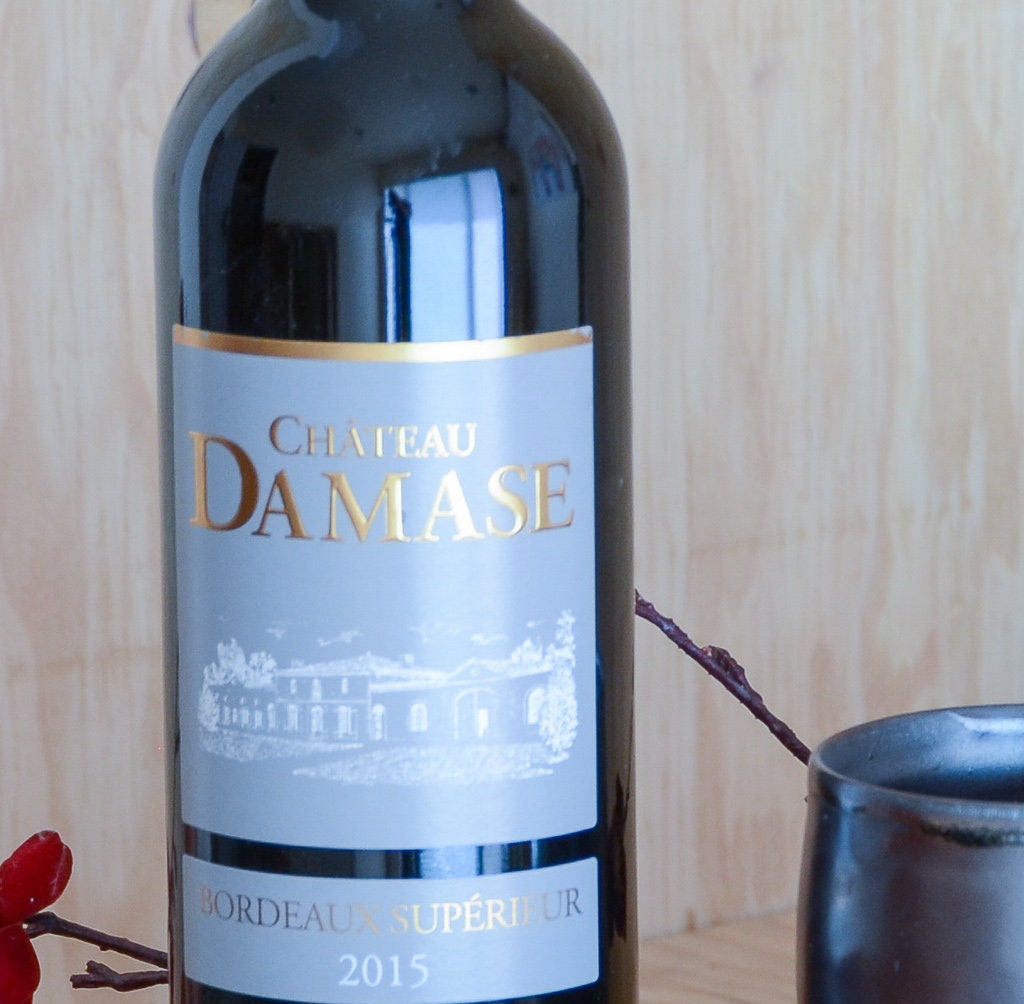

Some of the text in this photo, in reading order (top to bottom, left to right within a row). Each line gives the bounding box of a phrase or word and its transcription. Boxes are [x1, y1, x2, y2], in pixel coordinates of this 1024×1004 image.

[189, 431, 574, 543] DAMASE
[199, 886, 582, 935] BORDEAUX SUPÉRIEUR
[338, 953, 428, 988] 2015
